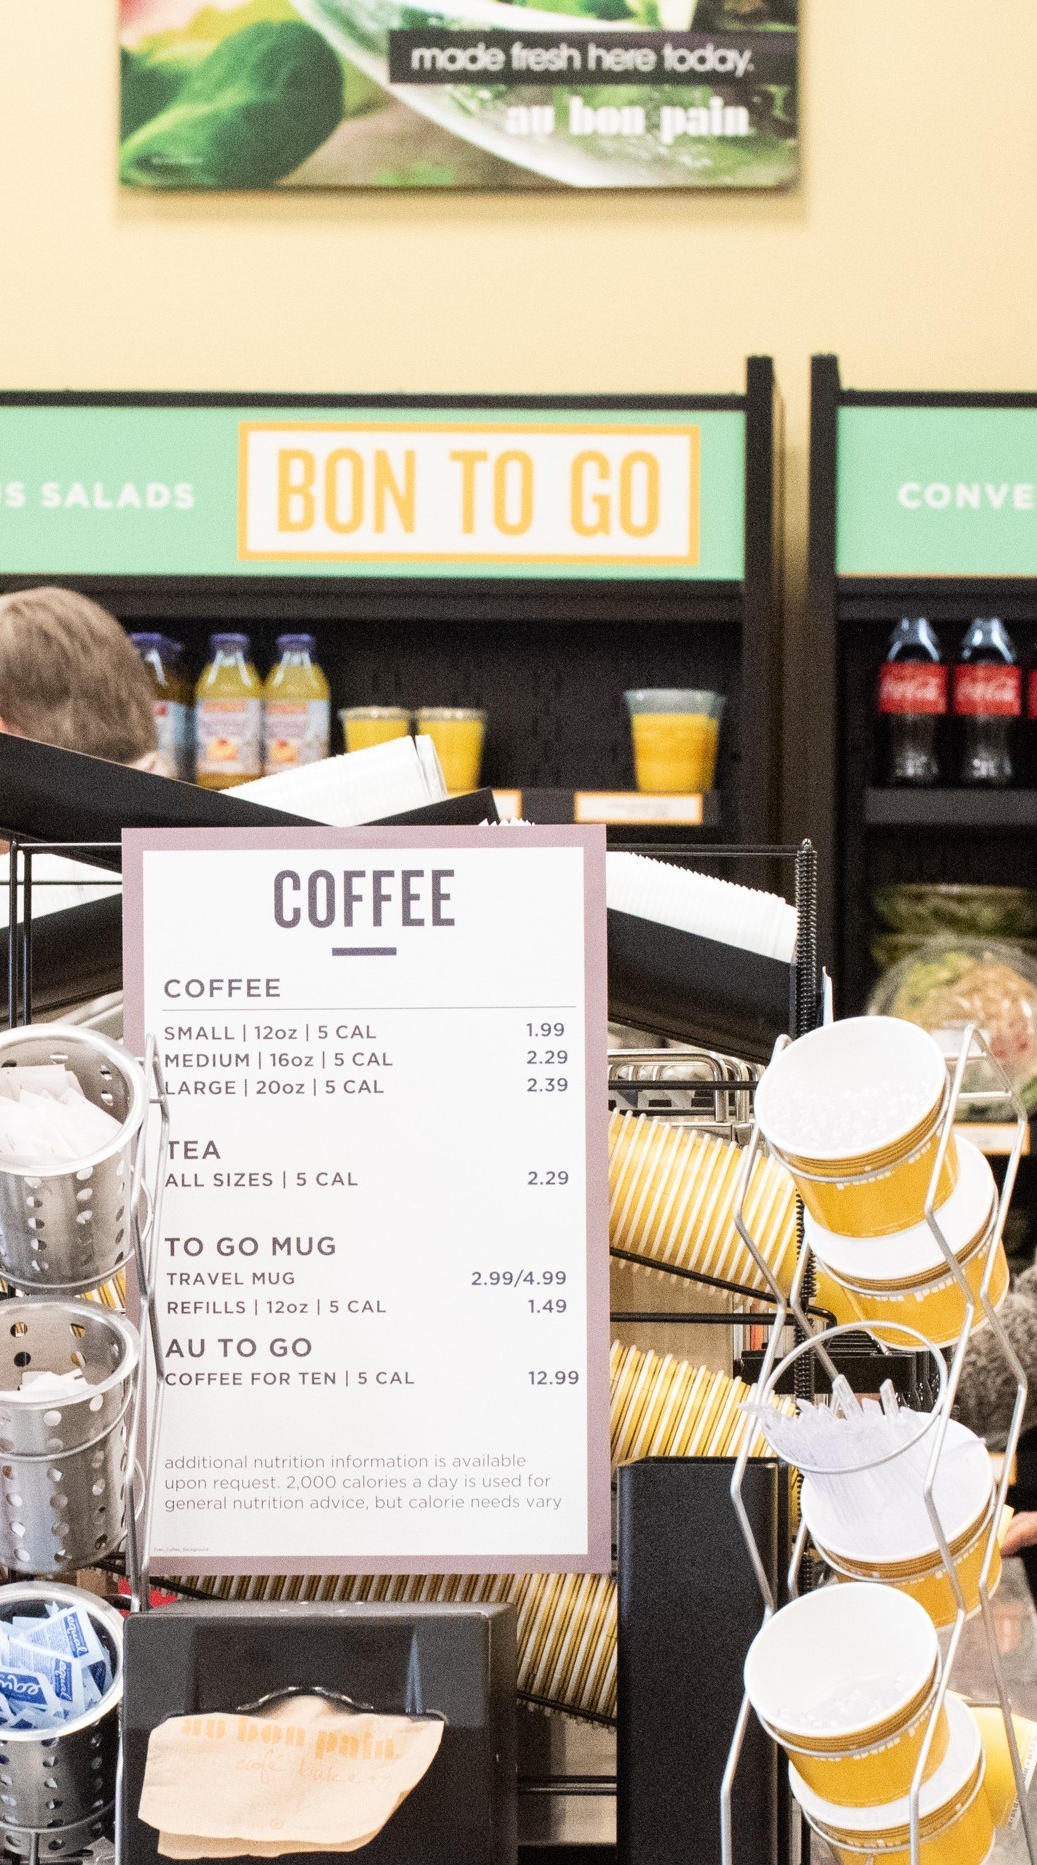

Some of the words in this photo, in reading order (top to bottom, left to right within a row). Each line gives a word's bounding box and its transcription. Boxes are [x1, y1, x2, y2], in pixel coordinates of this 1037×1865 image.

[412, 42, 505, 71] made
[512, 42, 581, 71] fresh
[588, 42, 657, 71] here
[507, 105, 555, 135] au
[570, 95, 645, 136] bon
[42, 482, 195, 509] SALADS
[277, 448, 417, 535] BON
[449, 450, 535, 536] TO
[570, 450, 661, 538] GO
[898, 482, 1034, 509] CONVE
[274, 869, 455, 929] COFFEE
[164, 978, 281, 998] COFFEE
[164, 1026, 235, 1041] SMALL
[254, 1026, 297, 1040] 12oz
[318, 1026, 328, 1040] 5
[335, 1025, 377, 1040] CAL
[526, 1023, 565, 1037] 1.99
[165, 1053, 250, 1068] MEDIUM
[270, 1053, 314, 1067] 16oz
[334, 1052, 344, 1067] 5
[352, 1052, 393, 1067] CAL
[526, 1050, 568, 1065] 2.29
[165, 1081, 236, 1095] LARGE
[256, 1080, 305, 1095] 20oz
[325, 1080, 336, 1094] 5
[343, 1079, 384, 1094] CAL
[527, 1078, 568, 1092] 2.39
[168, 1140, 221, 1160] TEA
[165, 1173, 205, 1188] ALL
[213, 1173, 273, 1187] SIZES
[296, 1172, 307, 1187] 5
[315, 1172, 358, 1187] CAL
[527, 1171, 569, 1185] 2.29
[165, 1237, 204, 1257] TO
[216, 1237, 259, 1257] GO
[271, 1236, 336, 1256] MUG
[167, 1272, 244, 1286] TRAVEL
[252, 1272, 295, 1286] MUG
[471, 1269, 567, 1288] 2.99/4.99
[167, 1300, 246, 1315] REFILLS
[266, 1300, 308, 1314] 12oz
[329, 1300, 339, 1314] 5
[347, 1300, 386, 1314] CAL
[528, 1299, 567, 1313] 1.49
[165, 1338, 205, 1358] AU
[217, 1338, 257, 1358] TO
[269, 1338, 312, 1358] GO
[165, 1372, 242, 1386] COFFEE
[250, 1372, 291, 1386] FOR
[298, 1372, 336, 1385] TEN
[358, 1371, 368, 1385] 5
[375, 1371, 415, 1385] CAL
[528, 1370, 580, 1385] 12.99
[165, 1456, 247, 1469] additional
[254, 1456, 325, 1468] nutrition
[331, 1454, 428, 1468] information
[435, 1455, 447, 1467] is
[452, 1454, 526, 1467] available
[165, 1479, 207, 1492] upon
[213, 1477, 280, 1491] request.
[286, 1475, 337, 1490] 2,000
[342, 1475, 407, 1488] calories
[412, 1478, 422, 1488] a
[427, 1475, 458, 1490] day
[464, 1475, 476, 1487] is
[482, 1474, 522, 1487] used
[528, 1474, 552, 1487] for
[165, 1497, 227, 1513] general
[233, 1497, 304, 1509] nutrition
[310, 1496, 369, 1510] advice,
[375, 1496, 402, 1509] but
[408, 1495, 465, 1509] calorie
[470, 1495, 520, 1508] needs
[526, 1498, 562, 1510] vary
[181, 1719, 225, 1740] au
[237, 1717, 306, 1748] bon
